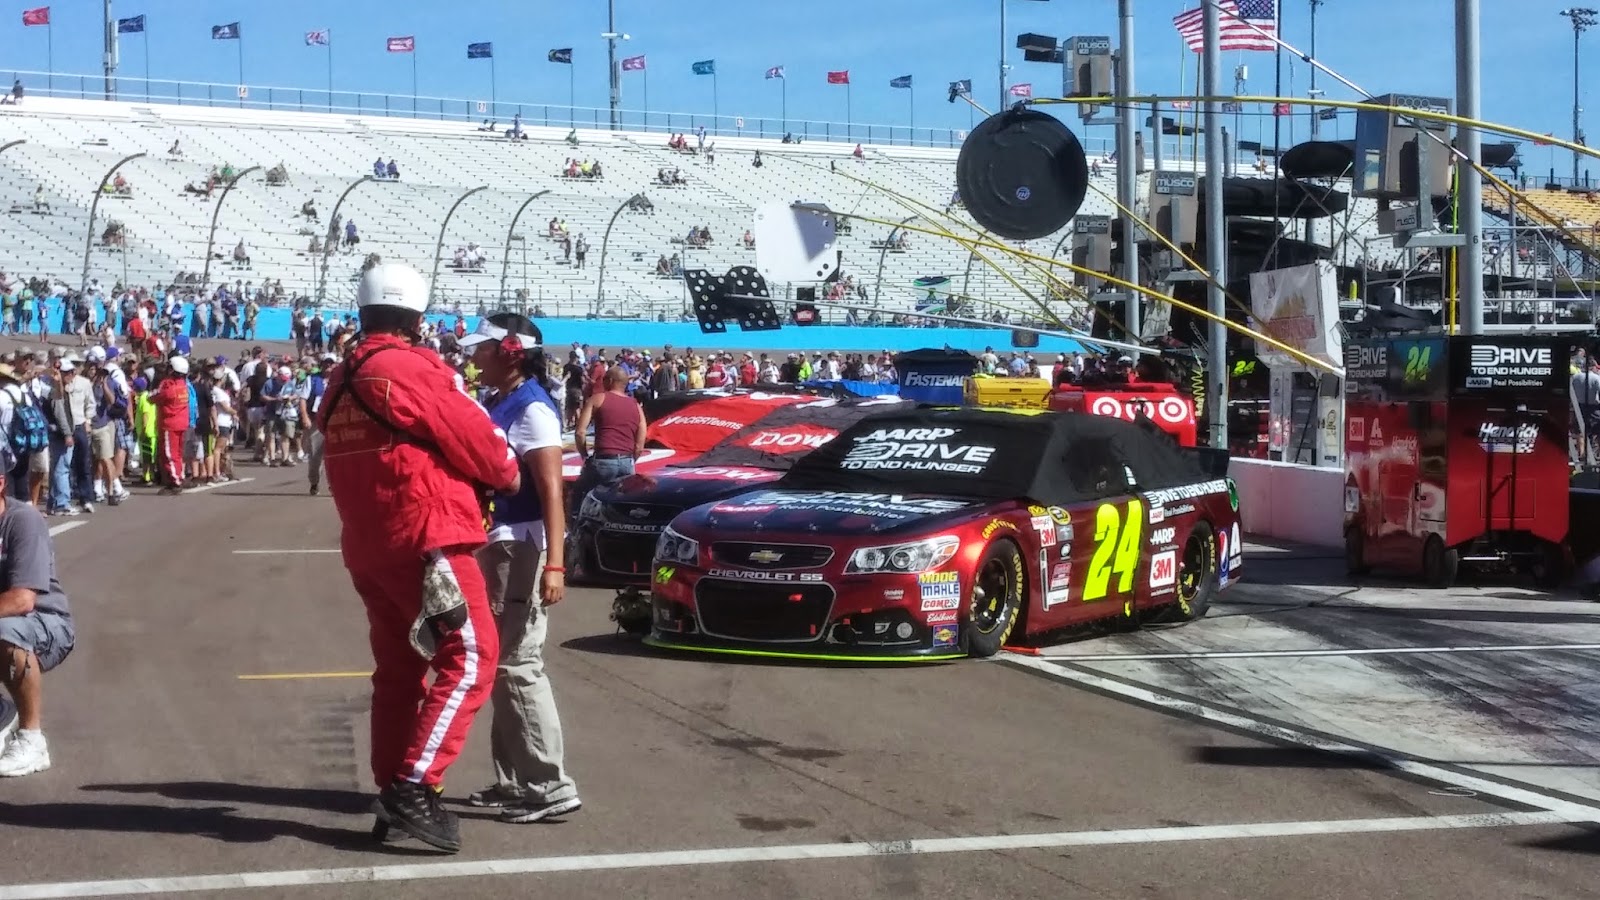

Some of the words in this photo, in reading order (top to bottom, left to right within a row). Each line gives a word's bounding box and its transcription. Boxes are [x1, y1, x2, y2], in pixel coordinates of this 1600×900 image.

[1155, 177, 1195, 187] musco
[1472, 235, 1479, 244] 6
[1347, 345, 1388, 368] DRIVE
[1405, 346, 1431, 380] 24
[1471, 345, 1552, 366] DRIVE
[1231, 360, 1256, 377] 24
[1471, 367, 1486, 375] TO
[1487, 367, 1508, 375] END
[1509, 367, 1552, 375] HUNGER
[749, 431, 838, 447] DOW
[853, 428, 956, 442] AARP
[844, 442, 996, 463] DRIVE
[840, 461, 862, 469] TO
[863, 461, 900, 469] END
[902, 461, 984, 474] HUNGER
[815, 504, 906, 519] Possibilities
[604, 521, 657, 531] CHEVROLET
[1041, 529, 1055, 544] 3M
[1150, 527, 1175, 545] AARP
[1082, 498, 1143, 601] 24
[708, 568, 796, 581] CHEVROLET
[800, 573, 823, 582] SS
[919, 571, 959, 583] MOOG
[1152, 558, 1172, 581] 3M
[922, 583, 959, 596] MAHLE
[923, 599, 950, 609] COMP
